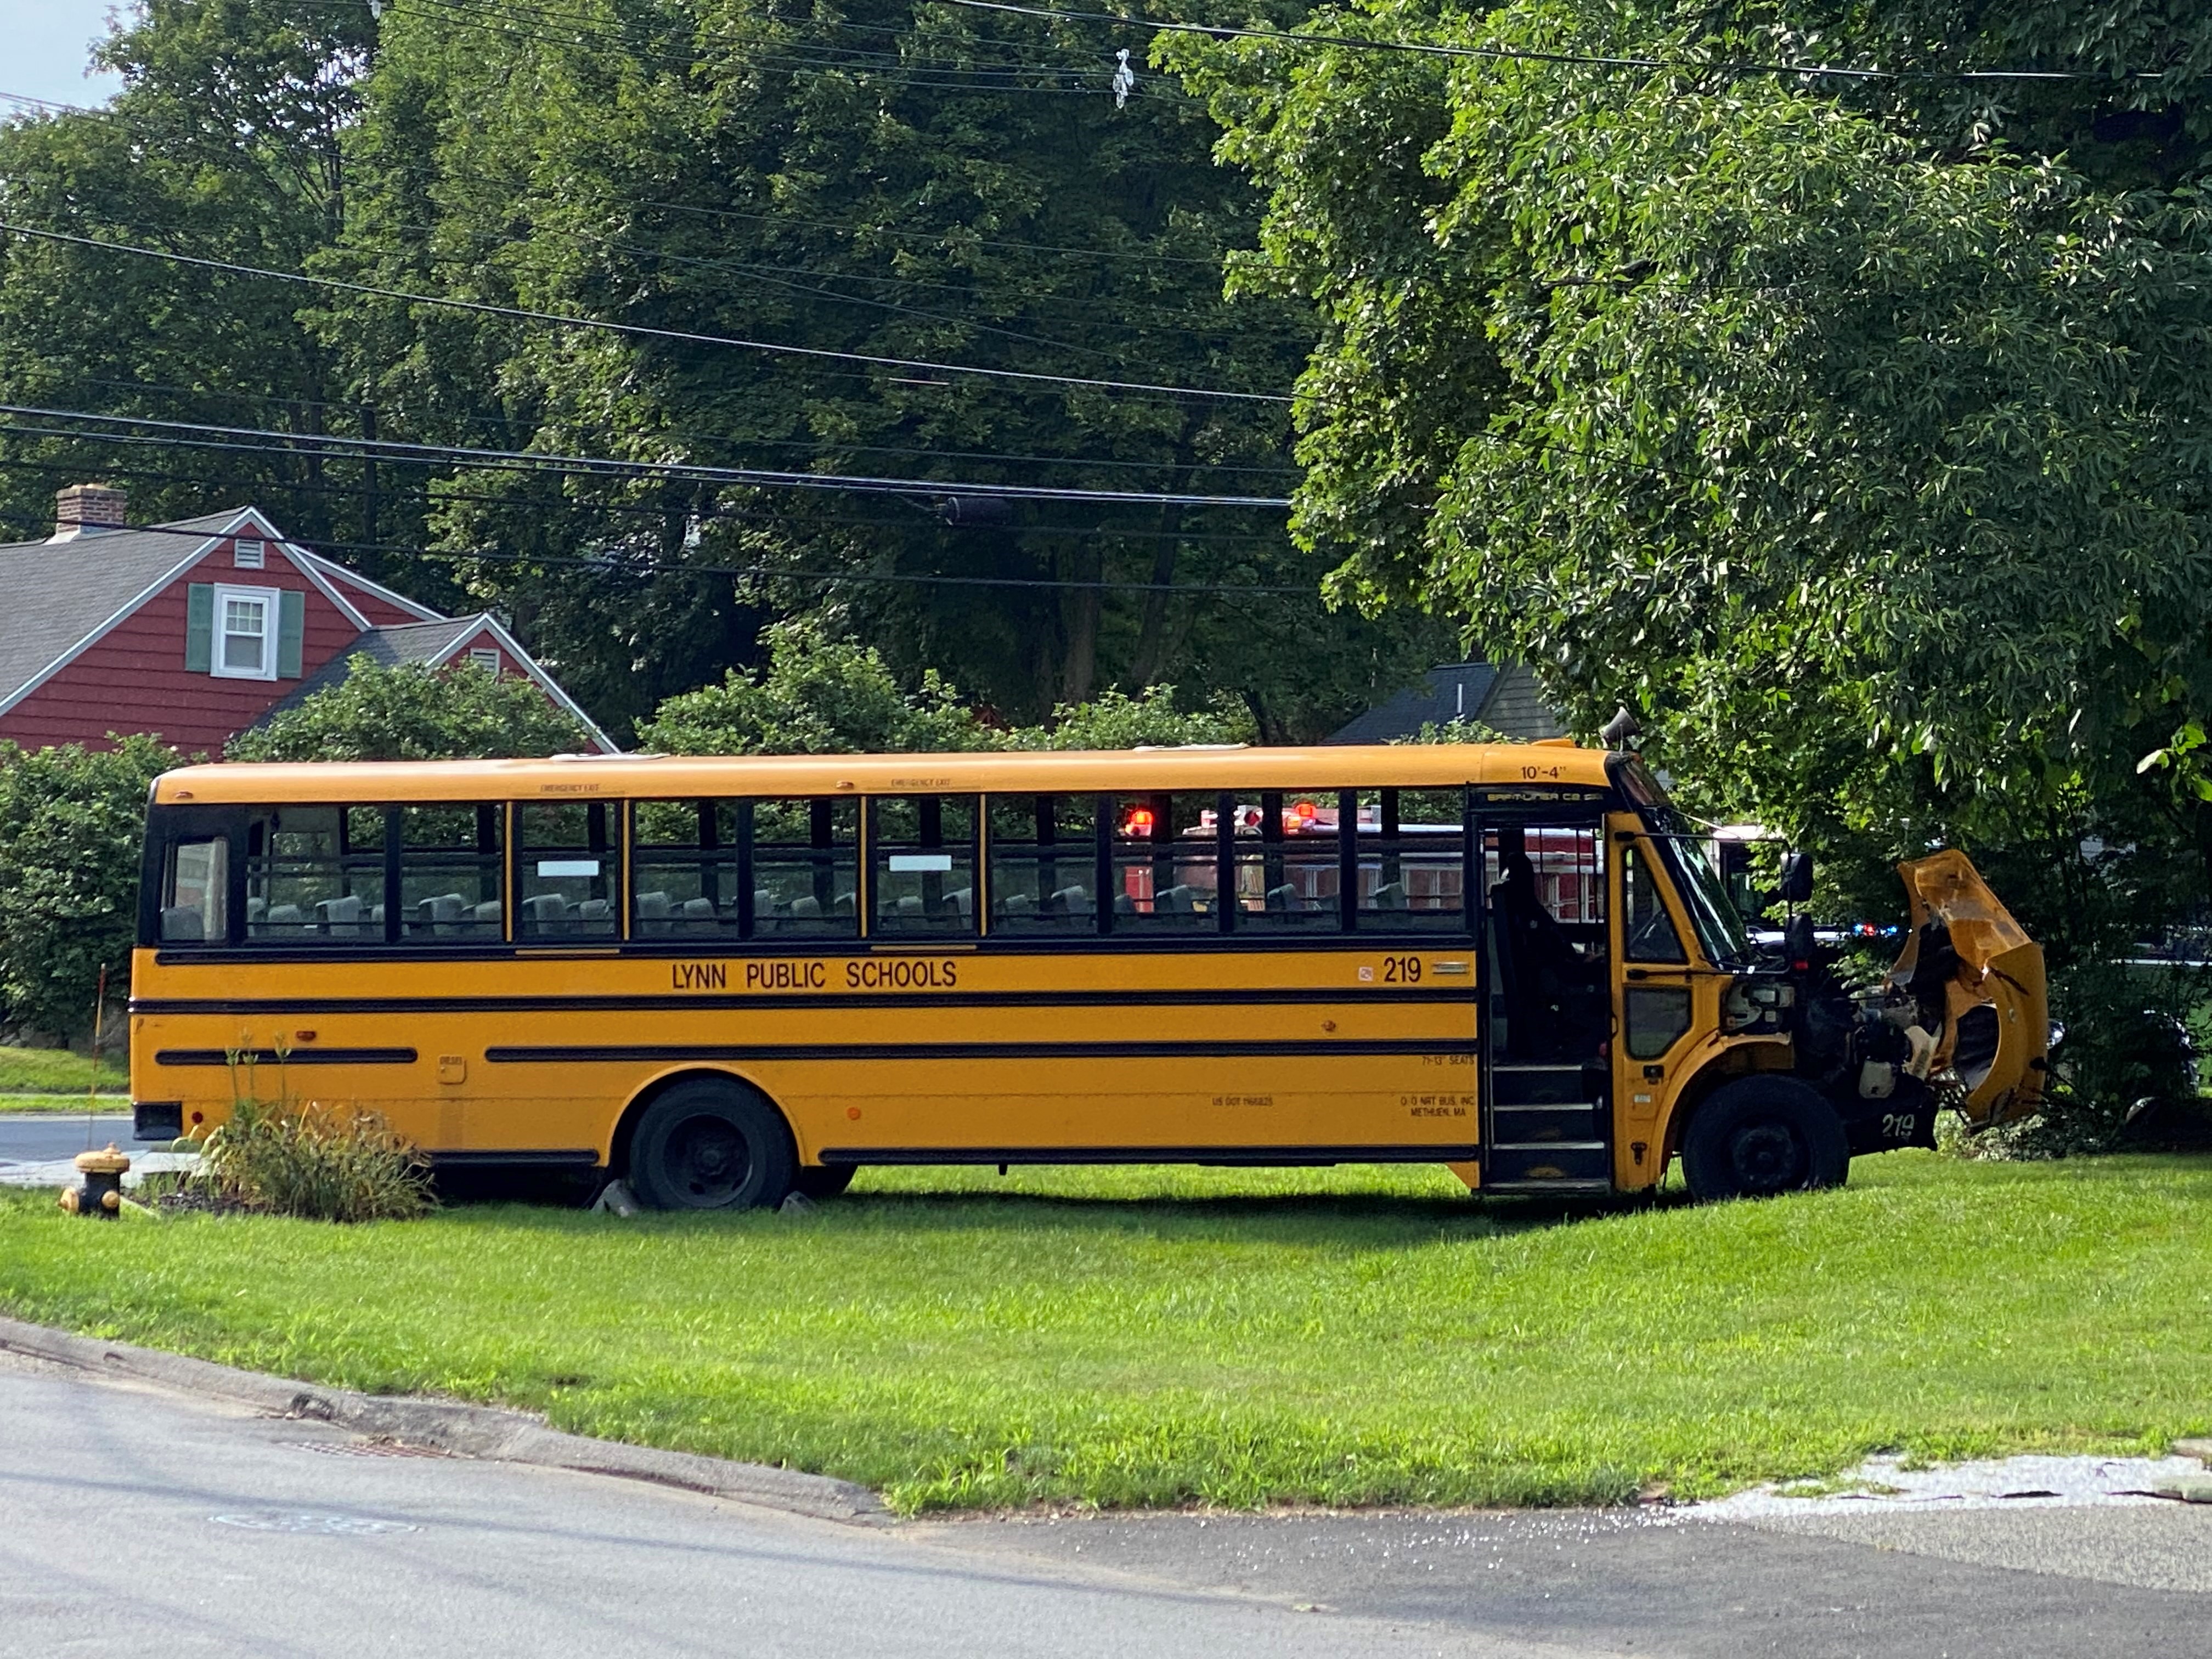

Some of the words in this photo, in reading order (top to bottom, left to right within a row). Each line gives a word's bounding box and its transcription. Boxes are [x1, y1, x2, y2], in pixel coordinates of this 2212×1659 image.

[672, 963, 726, 988] LYNN
[747, 962, 826, 988] PUBLIC
[846, 961, 957, 987] SCHOOLS
[1384, 957, 1421, 982] 219
[1449, 1055, 1474, 1065] SEATS
[1882, 1114, 1915, 1137] 219
